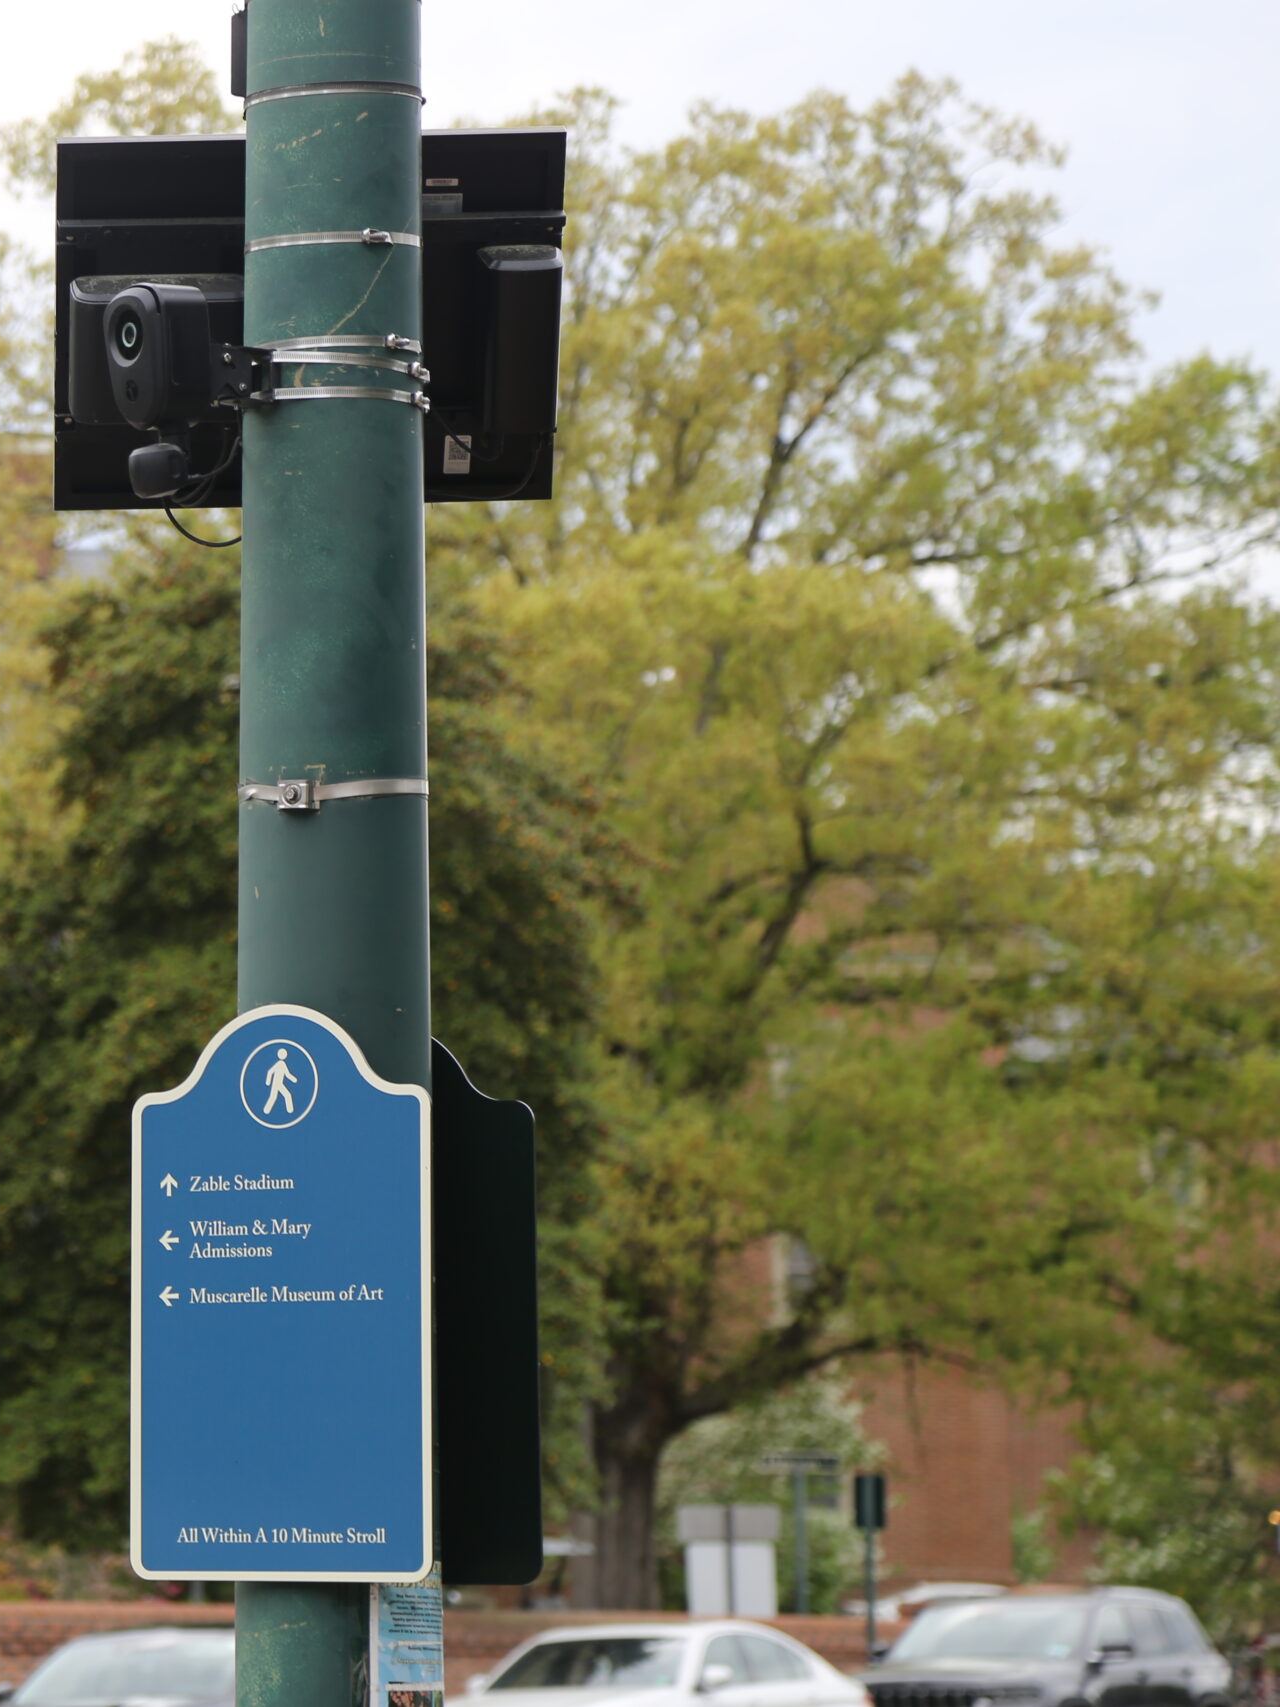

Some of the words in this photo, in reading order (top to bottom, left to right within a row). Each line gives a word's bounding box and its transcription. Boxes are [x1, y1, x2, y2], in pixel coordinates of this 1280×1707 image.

[189, 1175, 231, 1193] Zable
[233, 1173, 295, 1192] Stadium
[189, 1219, 249, 1237] William
[251, 1219, 269, 1236] &
[270, 1218, 312, 1240] Mary
[189, 1242, 273, 1259] Admissions
[189, 1286, 268, 1304] Muscarelle
[270, 1285, 336, 1303] Museum
[338, 1284, 356, 1301] of
[356, 1283, 384, 1301] Art
[176, 1527, 199, 1544] All
[200, 1527, 253, 1544] Within
[254, 1527, 269, 1544] A
[271, 1527, 289, 1544] 10
[291, 1527, 344, 1544] Minute
[346, 1527, 386, 1544] Stroll
